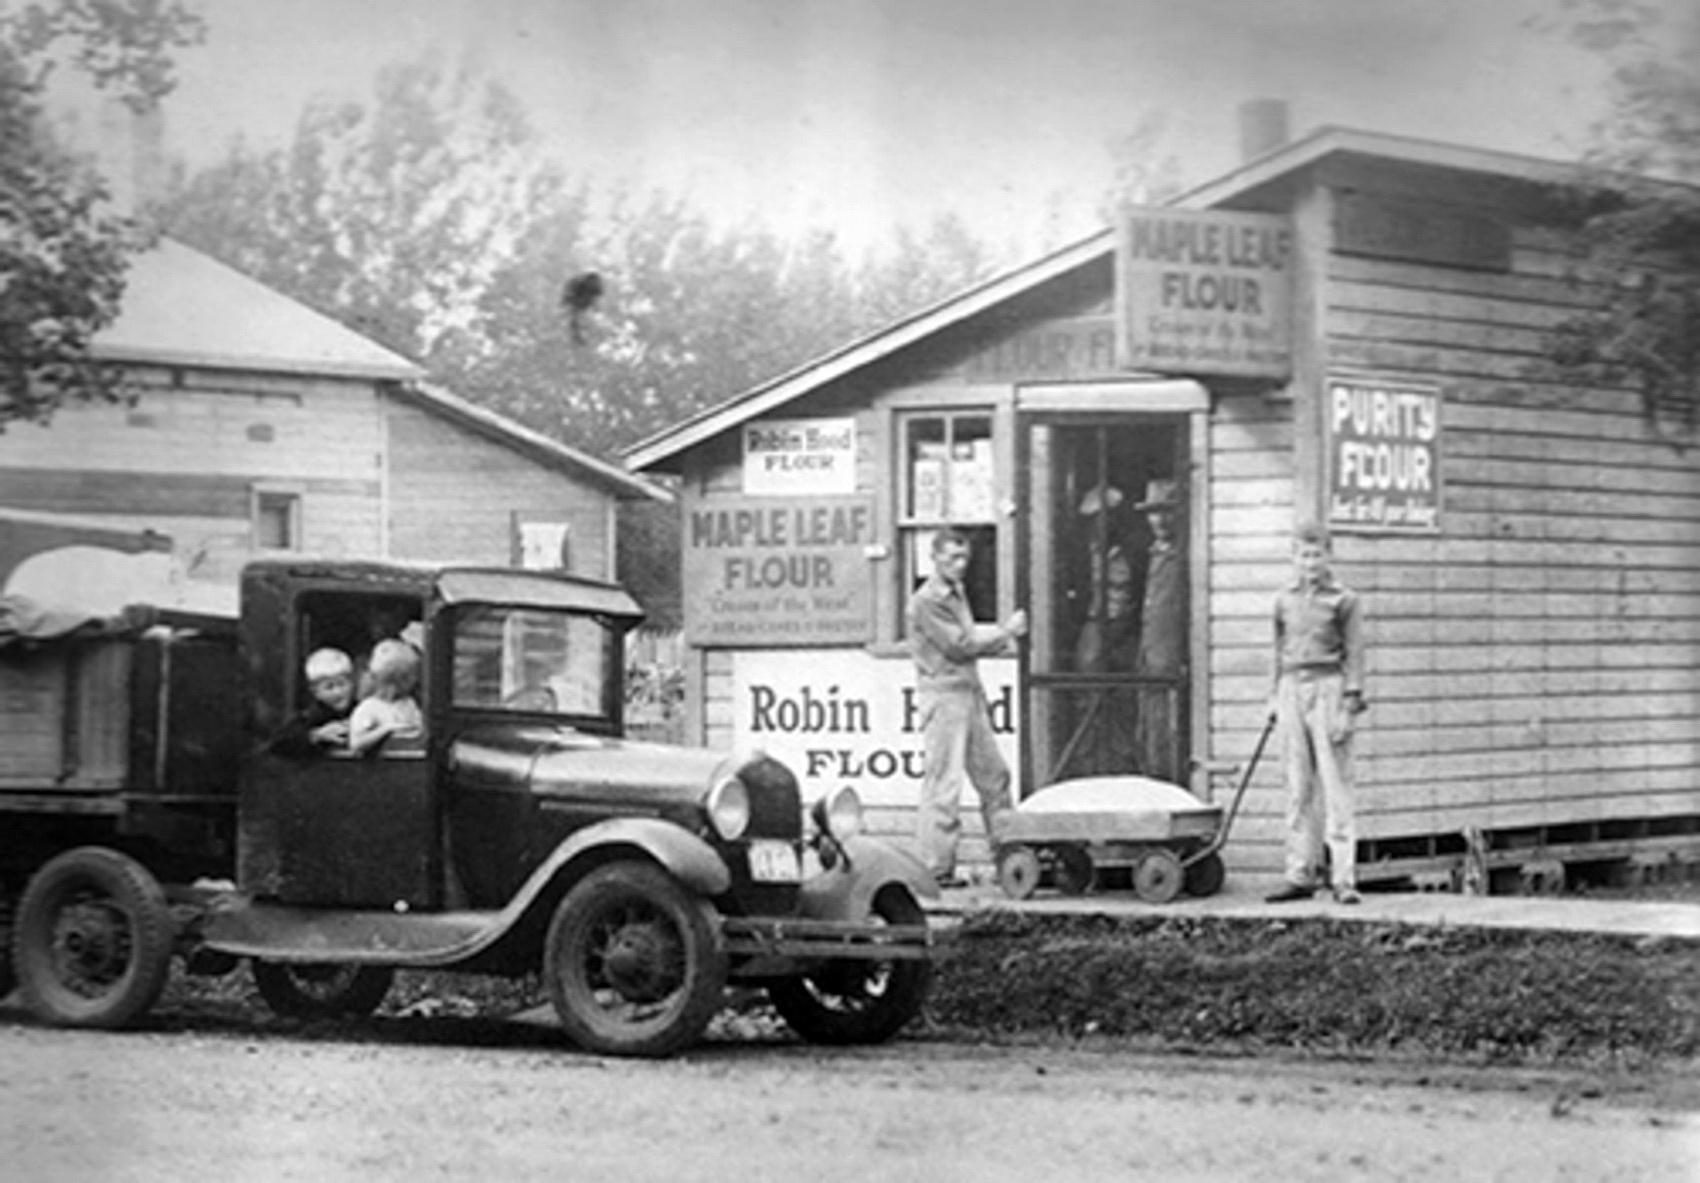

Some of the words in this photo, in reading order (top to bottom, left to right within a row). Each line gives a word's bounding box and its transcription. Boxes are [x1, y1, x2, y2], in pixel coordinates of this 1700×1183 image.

[1228, 225, 1293, 271] LEAF
[1162, 273, 1262, 314] FLOUR
[1332, 386, 1436, 441] PURITY
[765, 454, 834, 471] FLOUR
[1340, 440, 1431, 491] FLOUR
[691, 509, 787, 547] MAPLE
[796, 506, 867, 546] LEAF
[724, 556, 834, 589] FLOUR
[749, 685, 871, 732] Robin
[901, 685, 1015, 734] Hd
[805, 750, 926, 778] FLOU
